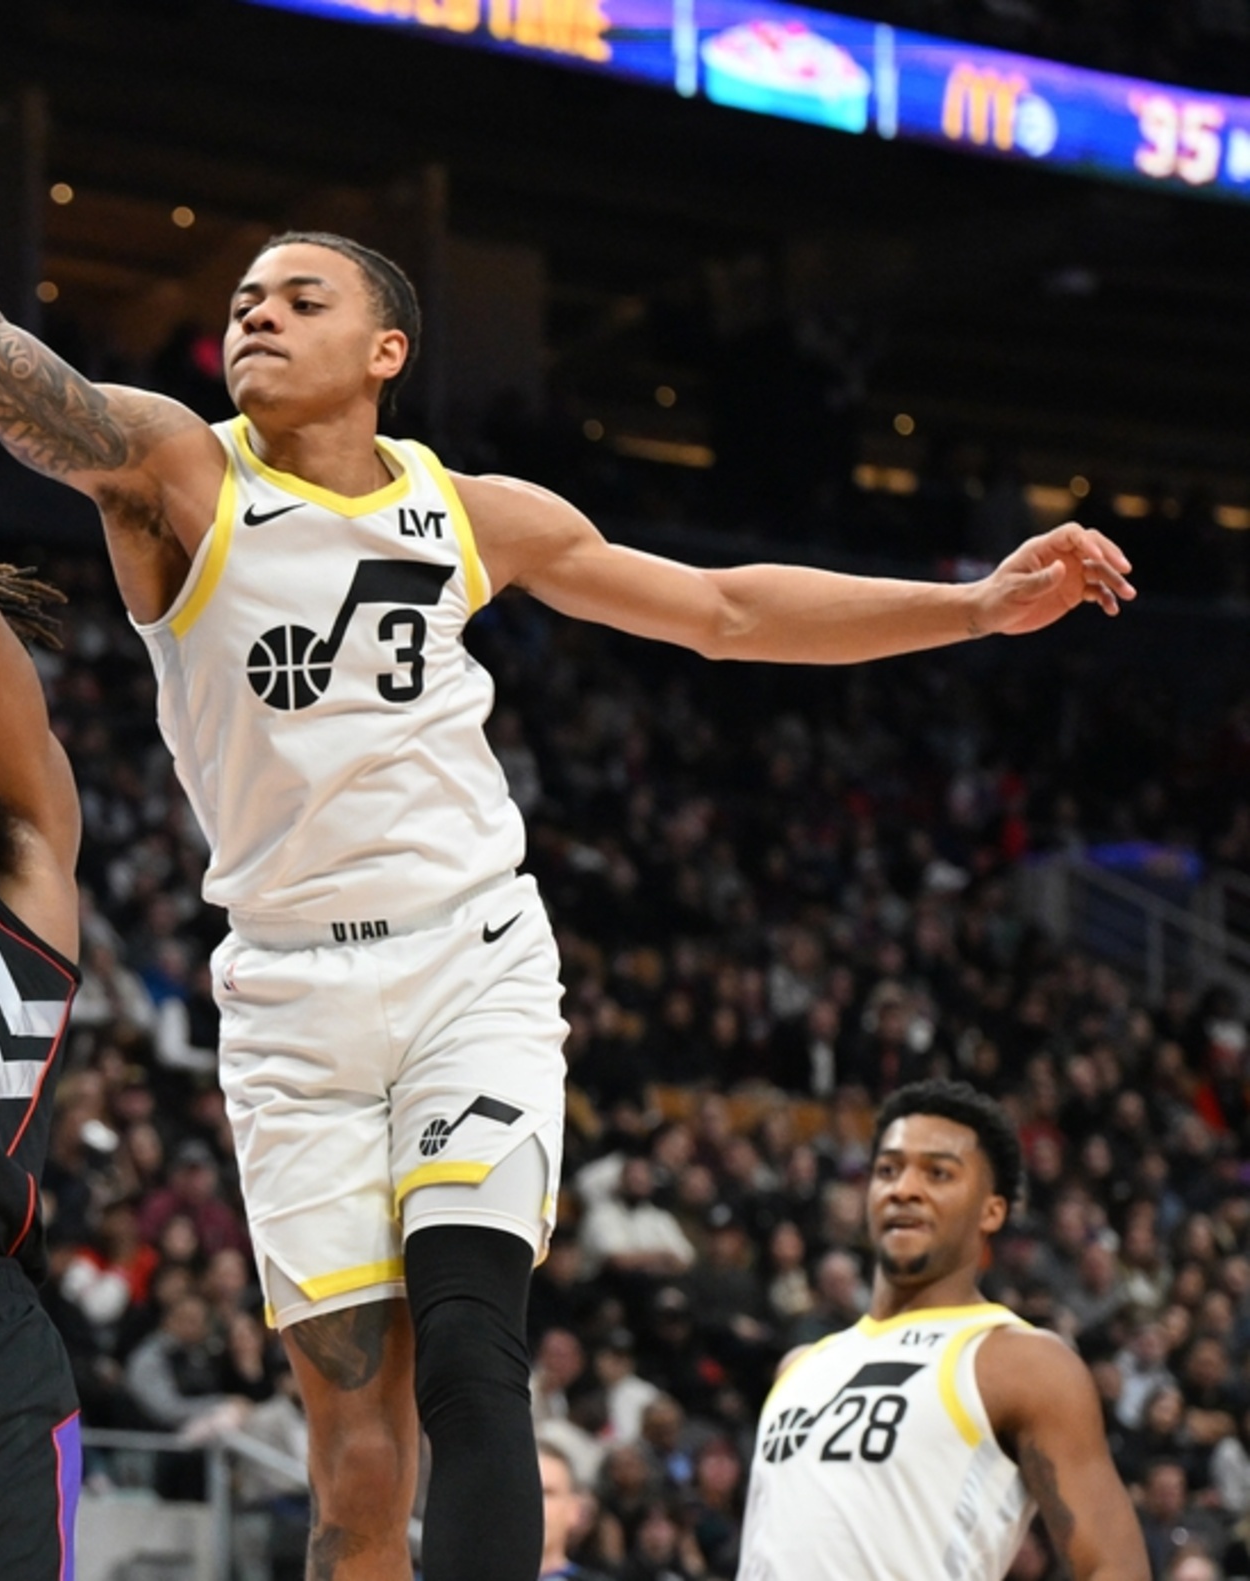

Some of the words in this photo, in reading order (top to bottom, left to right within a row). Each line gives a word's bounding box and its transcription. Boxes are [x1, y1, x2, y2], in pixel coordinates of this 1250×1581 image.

[398, 508, 447, 539] LVT
[376, 608, 427, 703] 3
[820, 1394, 908, 1464] 28
